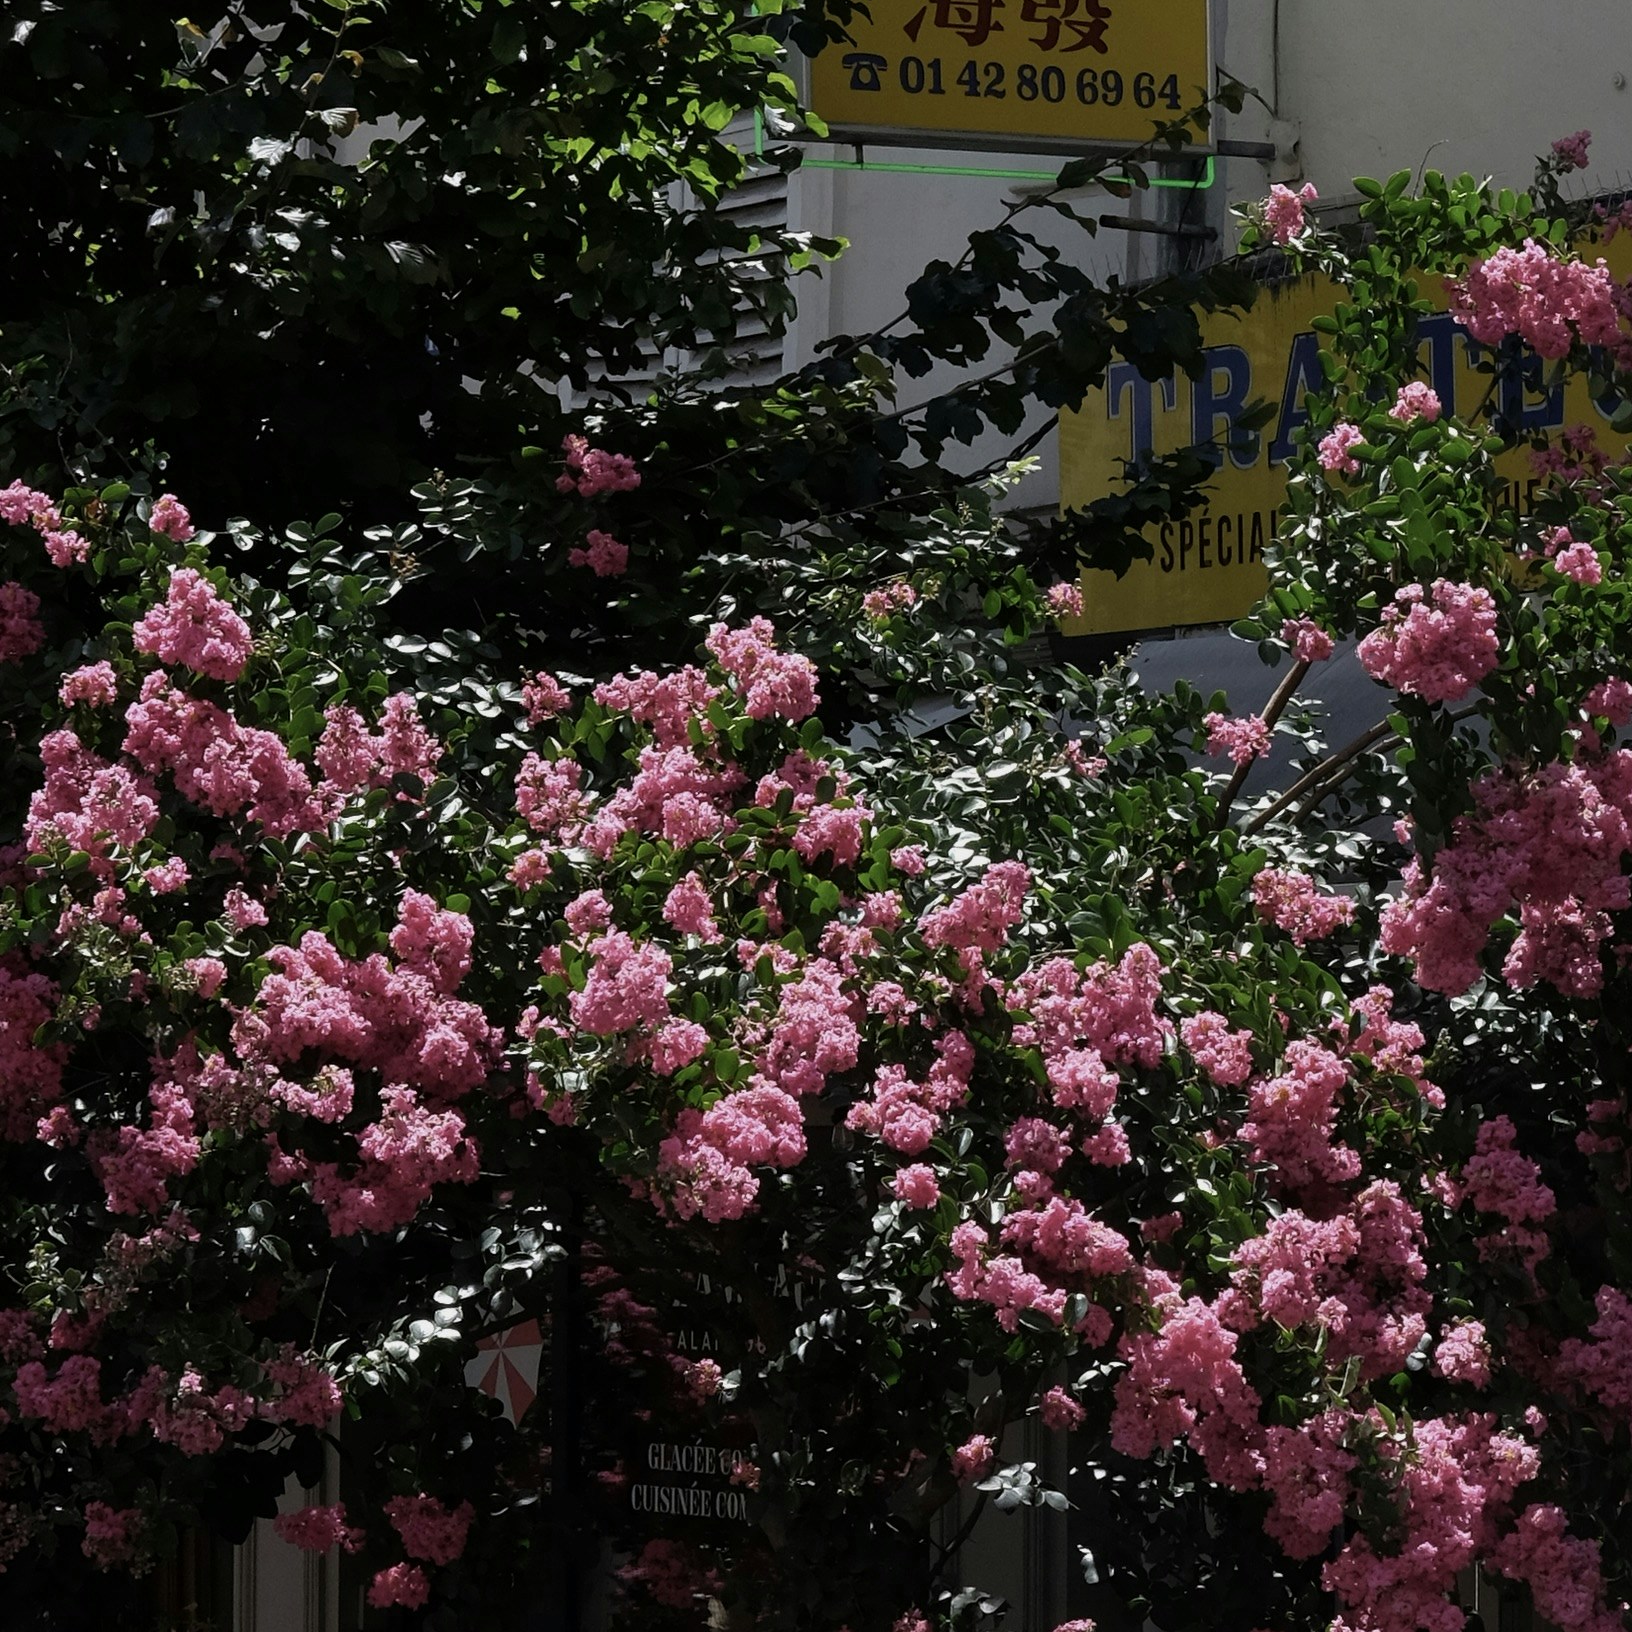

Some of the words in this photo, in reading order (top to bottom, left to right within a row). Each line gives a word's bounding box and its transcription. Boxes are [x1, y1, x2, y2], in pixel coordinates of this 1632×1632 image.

[900, 56, 946, 95] 01
[956, 60, 1006, 100] 42
[1016, 64, 1066, 104] 80
[1076, 68, 1123, 107] 69
[1133, 72, 1182, 110] 64
[647, 1437, 717, 1475] GLACÉE
[630, 1480, 712, 1518] CUISINÉE
